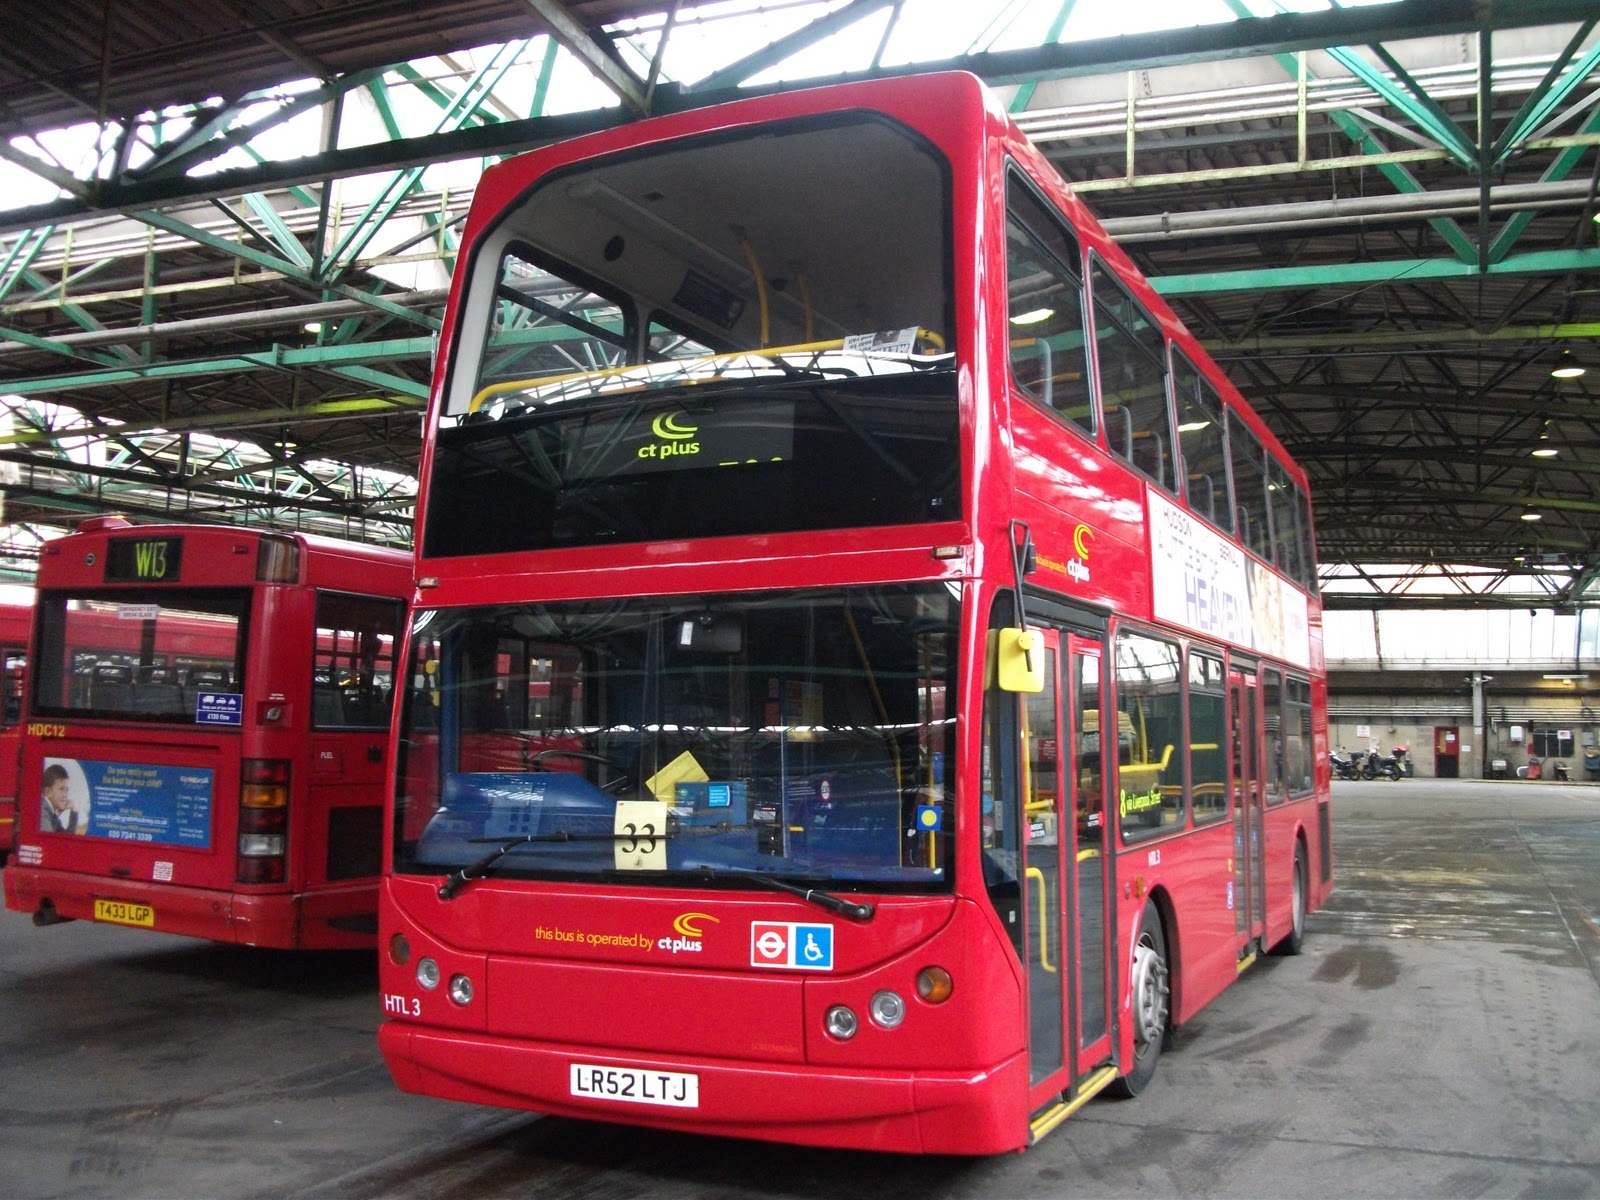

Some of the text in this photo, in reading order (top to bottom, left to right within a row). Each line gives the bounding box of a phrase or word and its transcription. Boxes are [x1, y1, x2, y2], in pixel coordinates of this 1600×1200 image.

[660, 441, 700, 459] plus
[1162, 505, 1193, 538] HUDSON
[136, 542, 168, 578] W13
[1184, 571, 1246, 643] HEAVEN
[27, 723, 65, 737] HDC12
[1120, 789, 1126, 818] 8
[1132, 791, 1150, 812] Liverpool
[109, 830, 120, 838] 020
[621, 822, 657, 854] 33
[99, 901, 150, 921] T433 LGP
[535, 926, 654, 952] this bus is operated by
[384, 993, 421, 1017] HTL 3
[577, 1067, 686, 1101] LR52 LTJ
